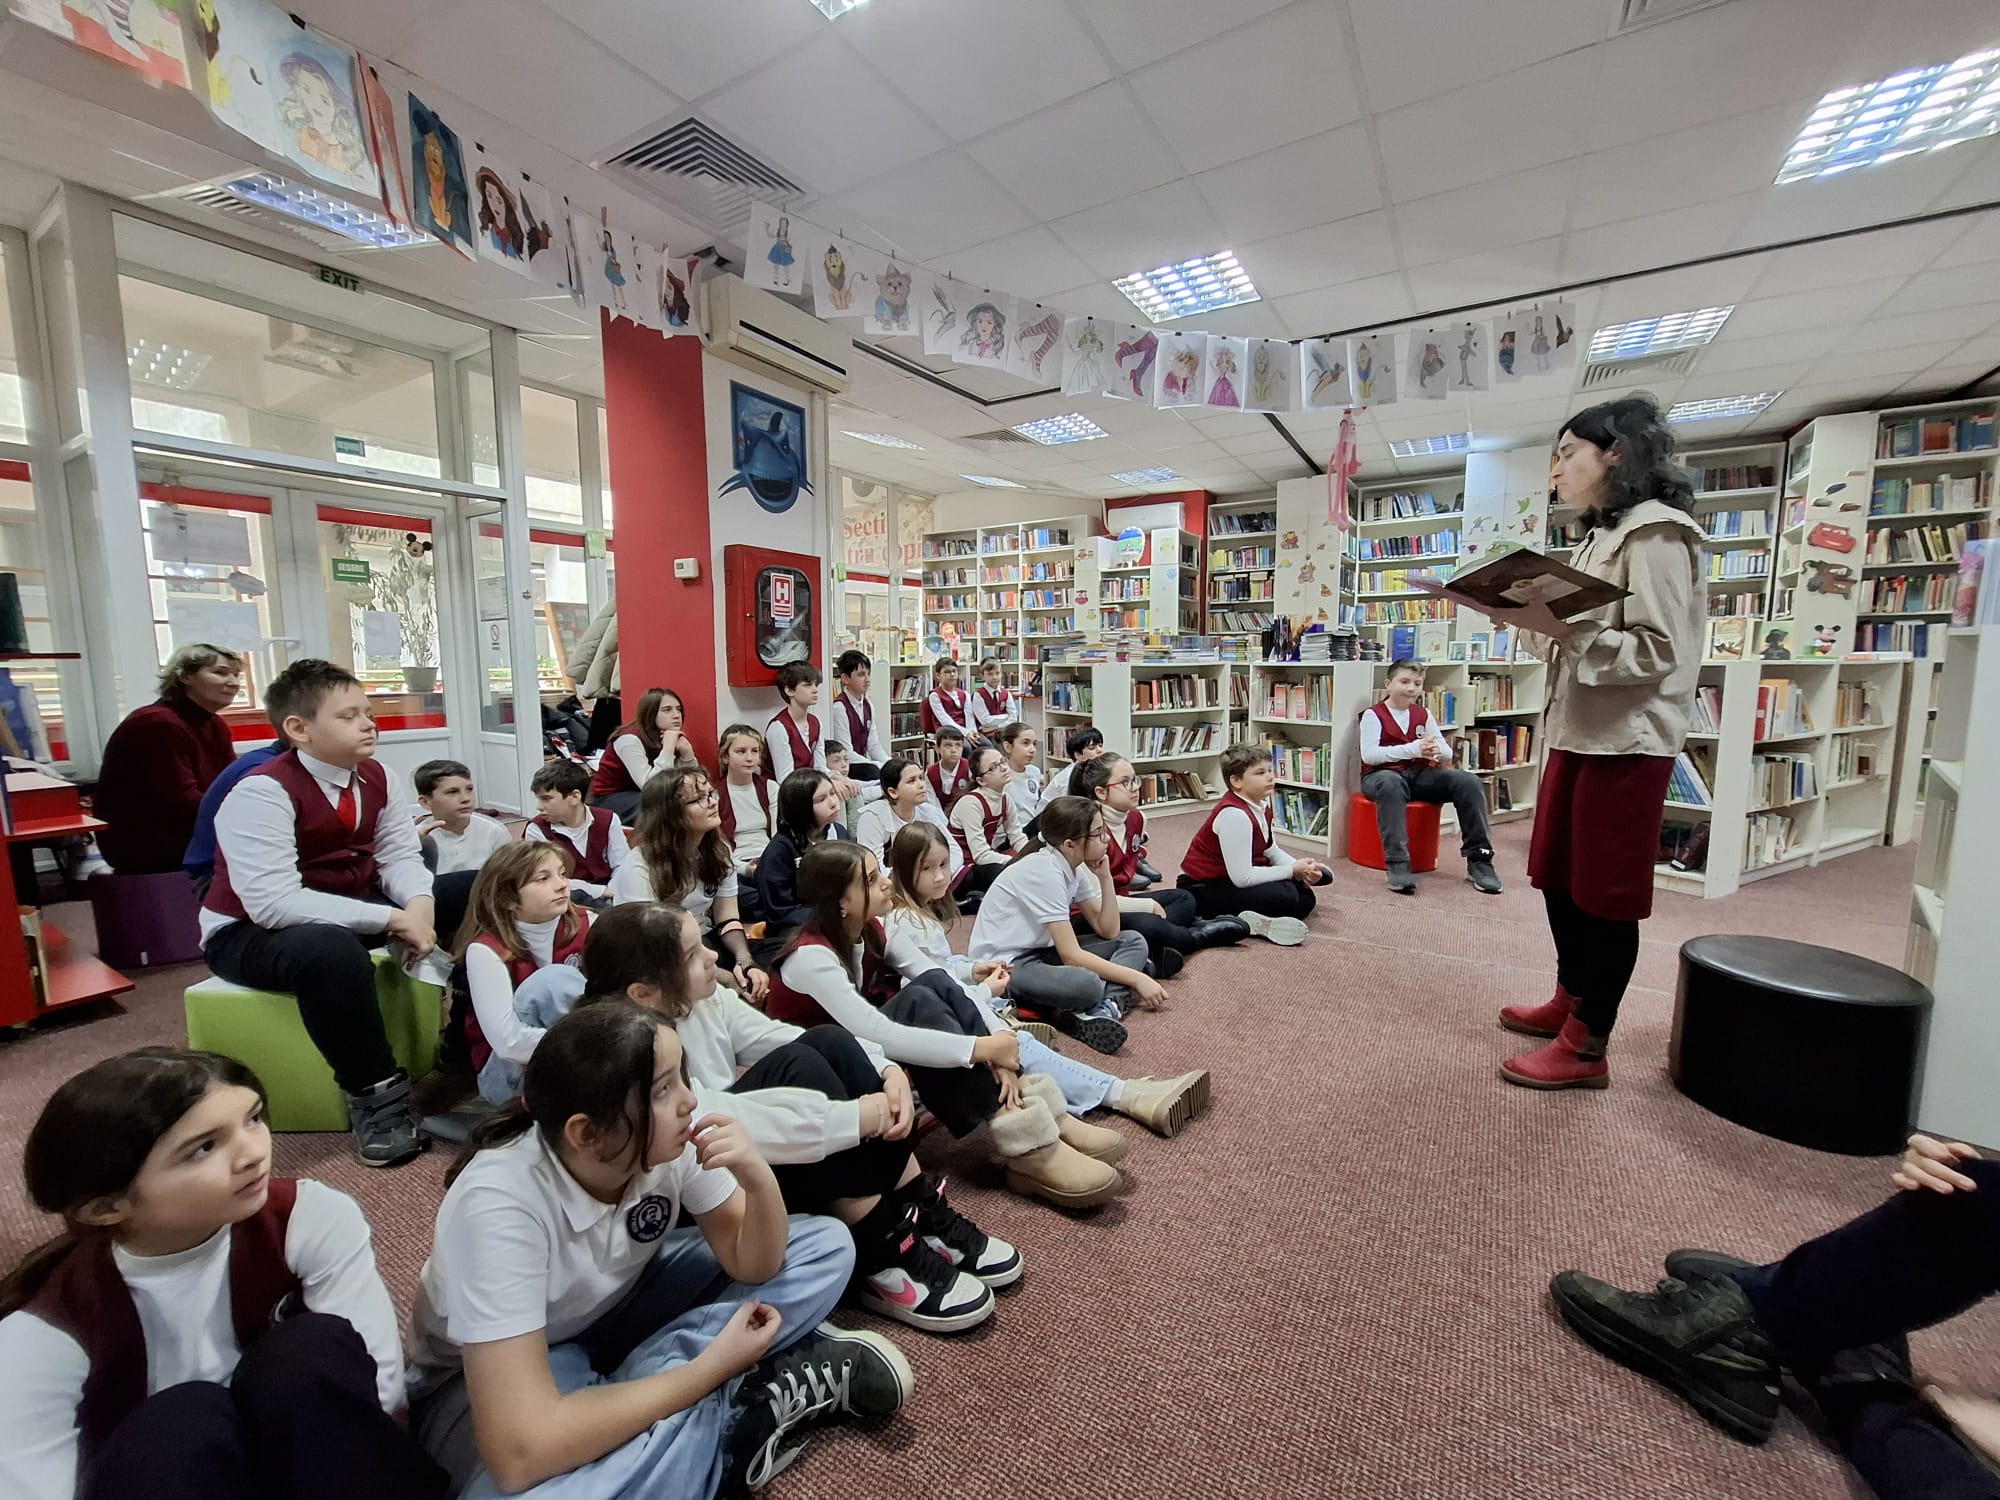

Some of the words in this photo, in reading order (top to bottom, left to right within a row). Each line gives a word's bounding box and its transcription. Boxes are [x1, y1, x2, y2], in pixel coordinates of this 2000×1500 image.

[320, 269, 360, 292] EXIT
[775, 581, 789, 601] H
[1268, 699, 1276, 715] A
[1279, 761, 1286, 777] B
